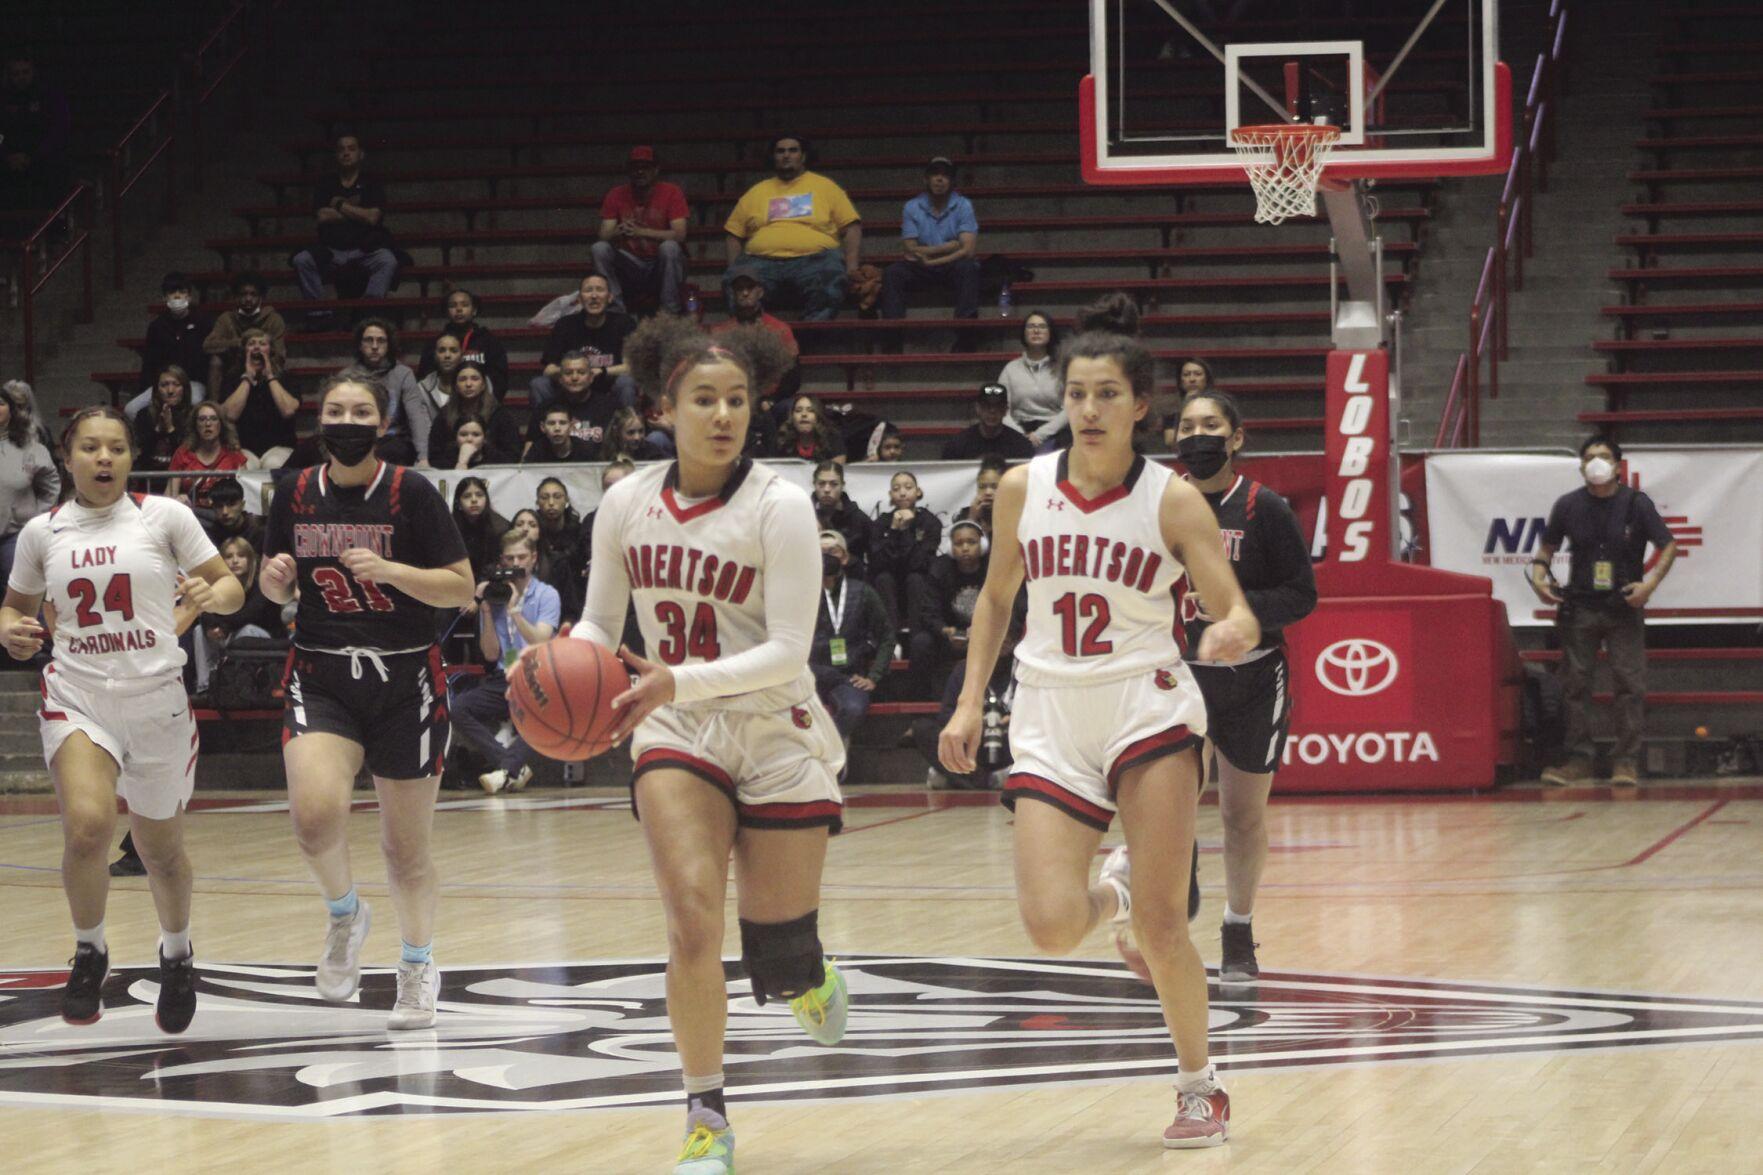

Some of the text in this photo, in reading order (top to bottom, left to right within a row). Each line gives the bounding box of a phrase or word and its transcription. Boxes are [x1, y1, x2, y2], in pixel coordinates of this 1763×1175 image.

[1337, 353, 1374, 562] LOBOS
[71, 545, 117, 570] LADY
[623, 544, 757, 605] OBERTSON
[1019, 534, 1162, 594] OBERTSON
[67, 573, 134, 629] 24
[312, 567, 394, 612] 21
[68, 629, 156, 655] CARDINALS
[654, 601, 721, 666] 34
[1052, 592, 1113, 657] 12
[1282, 731, 1439, 765] TOYOTA
